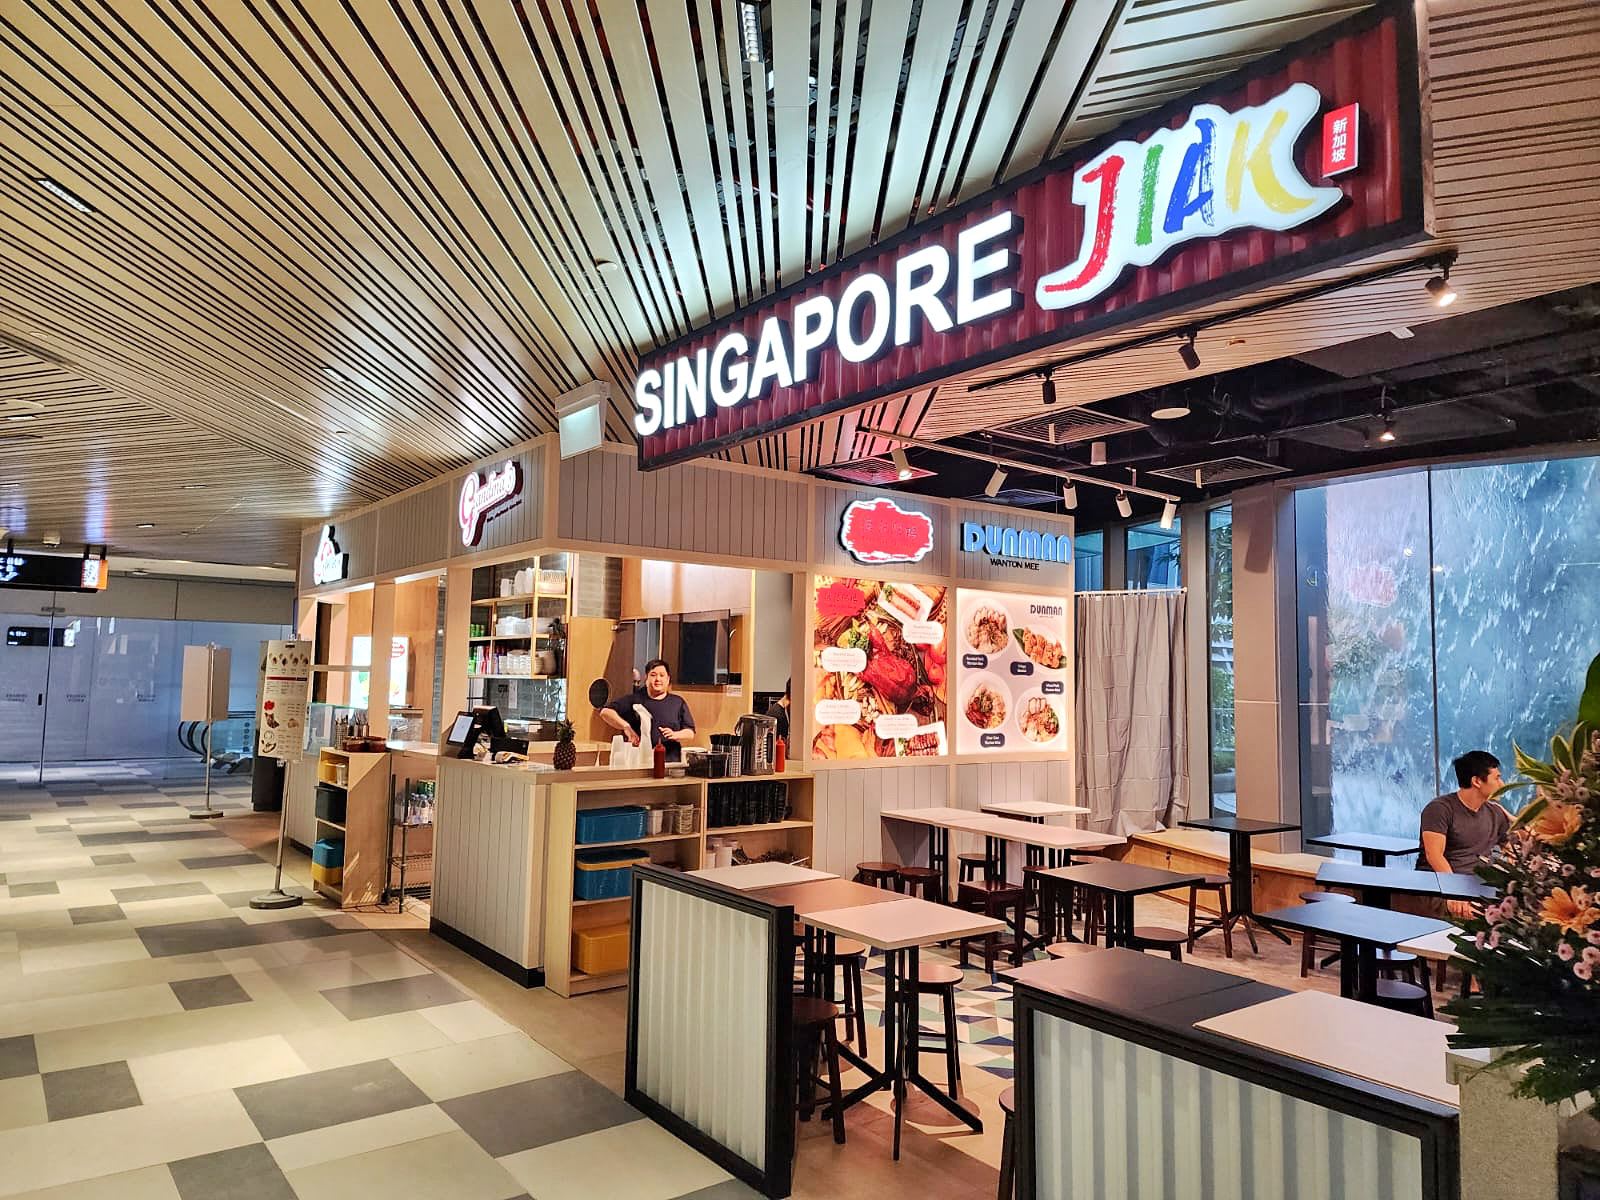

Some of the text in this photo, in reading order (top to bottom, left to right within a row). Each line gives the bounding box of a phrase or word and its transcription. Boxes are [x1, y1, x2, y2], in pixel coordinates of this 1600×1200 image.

[1331, 116, 1348, 163] 新加坡
[634, 107, 1317, 437] SINGAPORE JIAK
[962, 521, 1072, 564] DUNMAN
[989, 558, 1040, 571] WANTON MEE
[1030, 604, 1062, 616] DUNMAN
